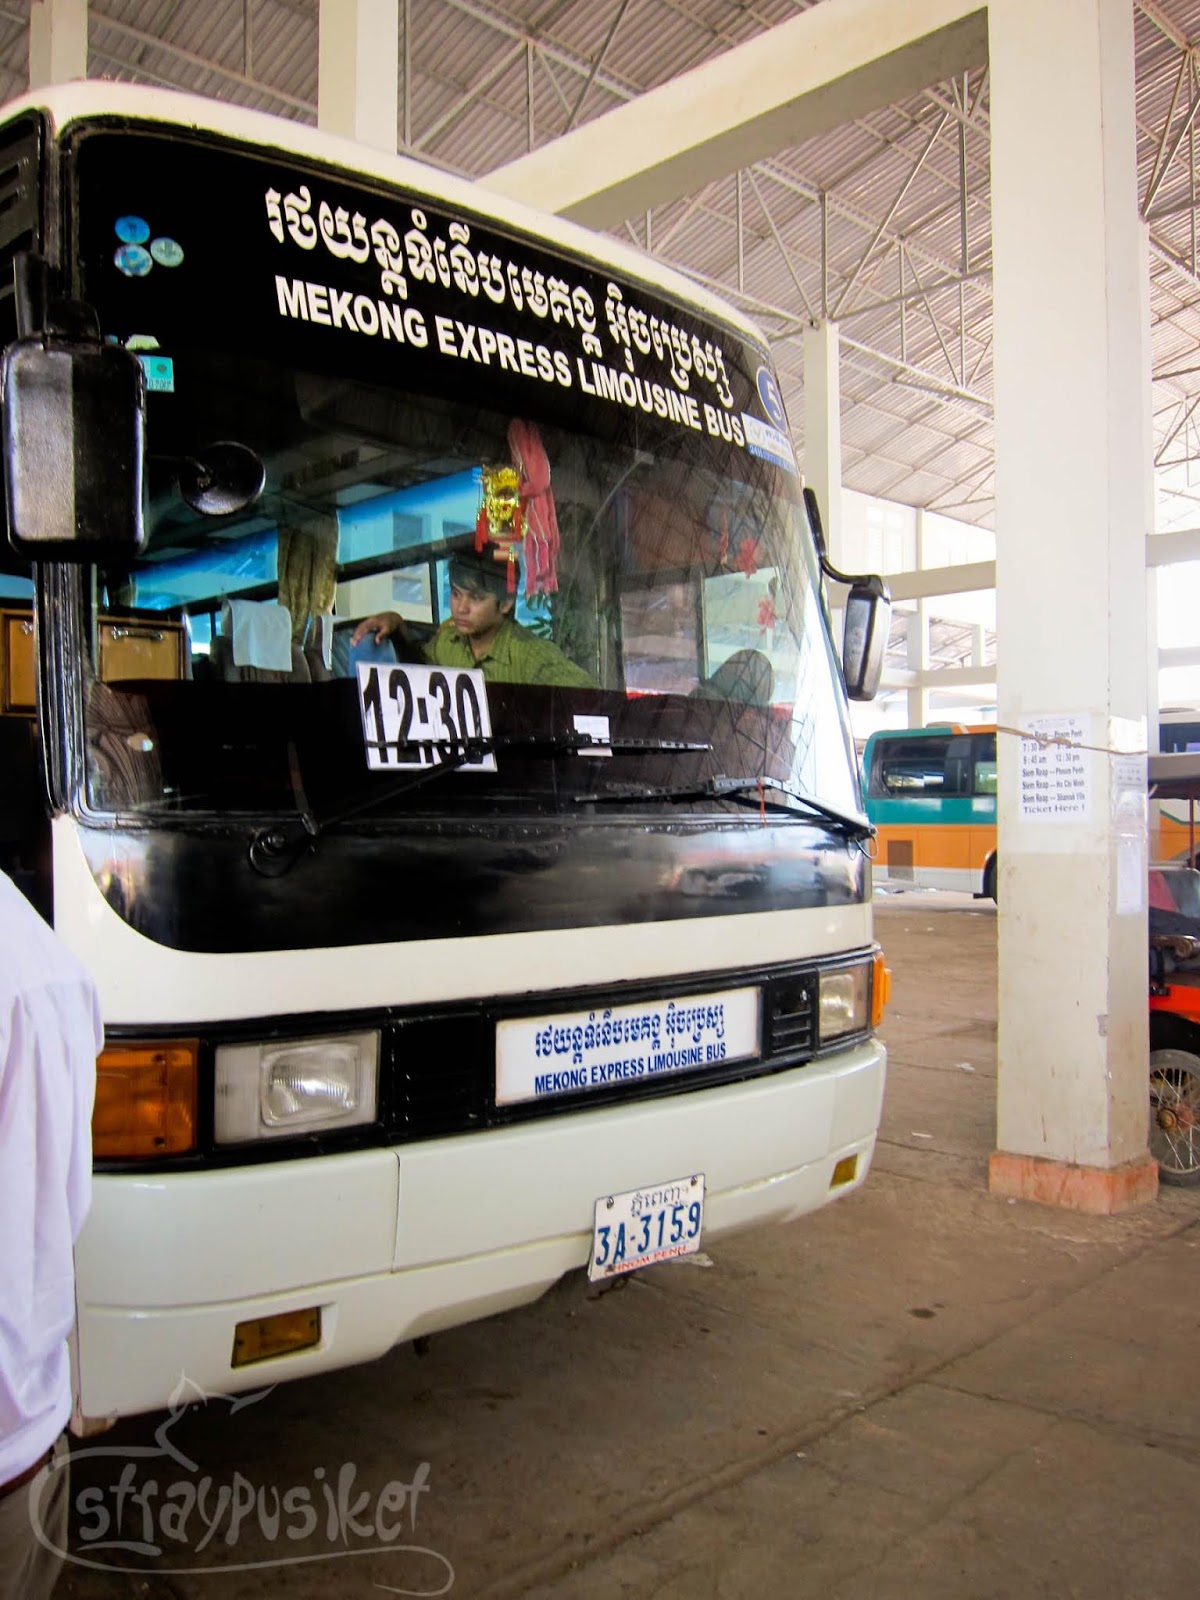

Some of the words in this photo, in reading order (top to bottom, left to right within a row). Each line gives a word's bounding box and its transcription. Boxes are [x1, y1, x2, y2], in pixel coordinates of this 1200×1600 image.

[275, 275, 428, 348] MEKONG
[435, 315, 573, 387] EXPRESS
[577, 356, 701, 430] LIMOUSINE
[704, 402, 745, 447] BUS
[1022, 768, 1035, 778] Siem
[1036, 767, 1048, 778] Reap
[1056, 767, 1071, 775] Phnom
[1072, 766, 1084, 775] Penh
[1022, 781, 1035, 790] Siem
[1036, 780, 1049, 790] Reap
[1022, 794, 1035, 803] Siem
[1036, 793, 1049, 804] Reap
[1024, 806, 1051, 814] Ticket
[534, 1069, 587, 1095] MEKONG
[591, 1057, 645, 1084] EXPRESS
[648, 1046, 704, 1073] LIMOUSINE
[706, 1042, 726, 1060] BUS
[596, 1201, 701, 1266] 3A-3159
